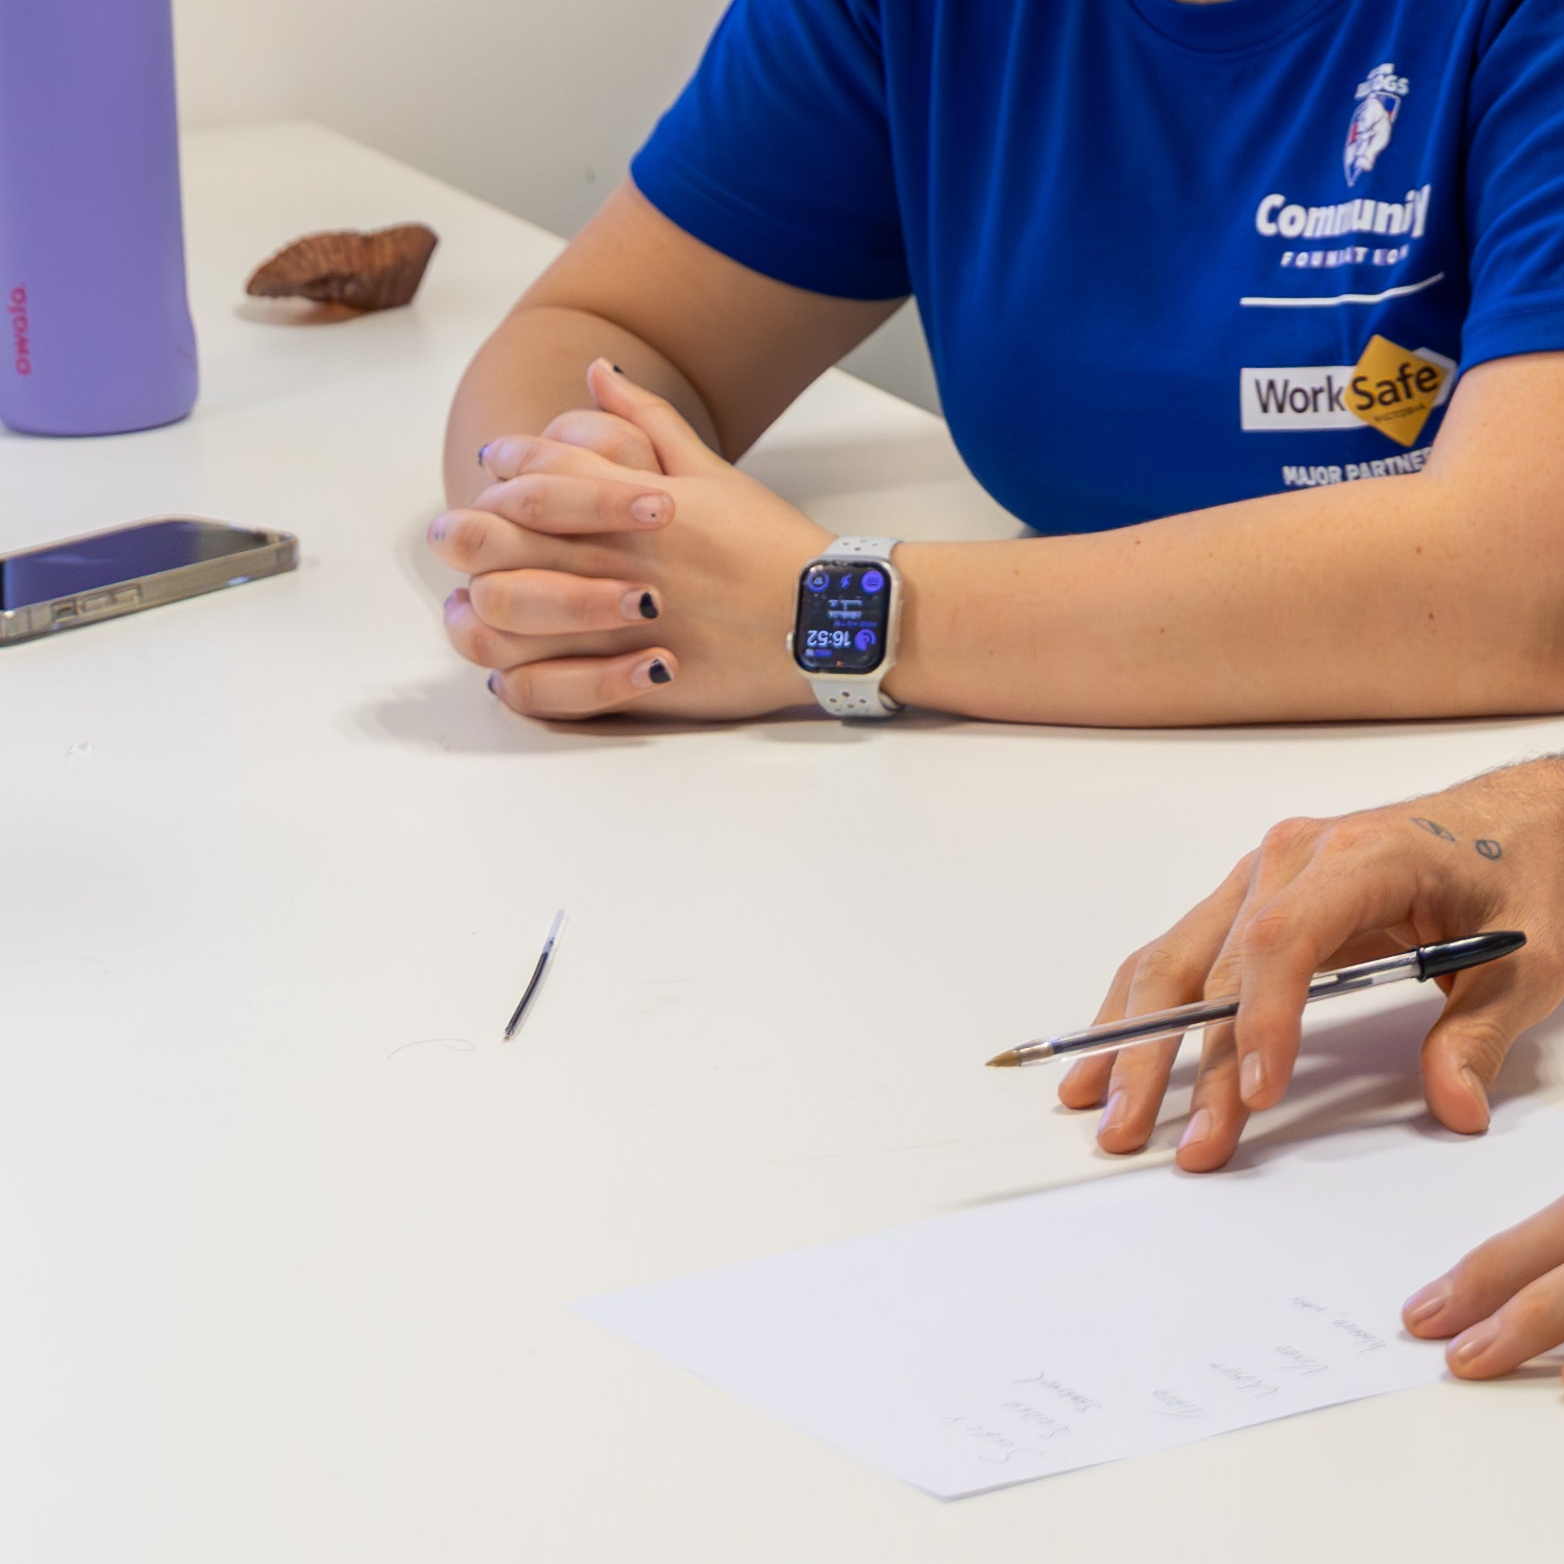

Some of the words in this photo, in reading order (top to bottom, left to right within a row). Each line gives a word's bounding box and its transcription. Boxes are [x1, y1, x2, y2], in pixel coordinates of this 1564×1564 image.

[8, 285, 32, 377] owala
[1282, 465, 1343, 487] MAJOR
[806, 629, 851, 648] 16:52
